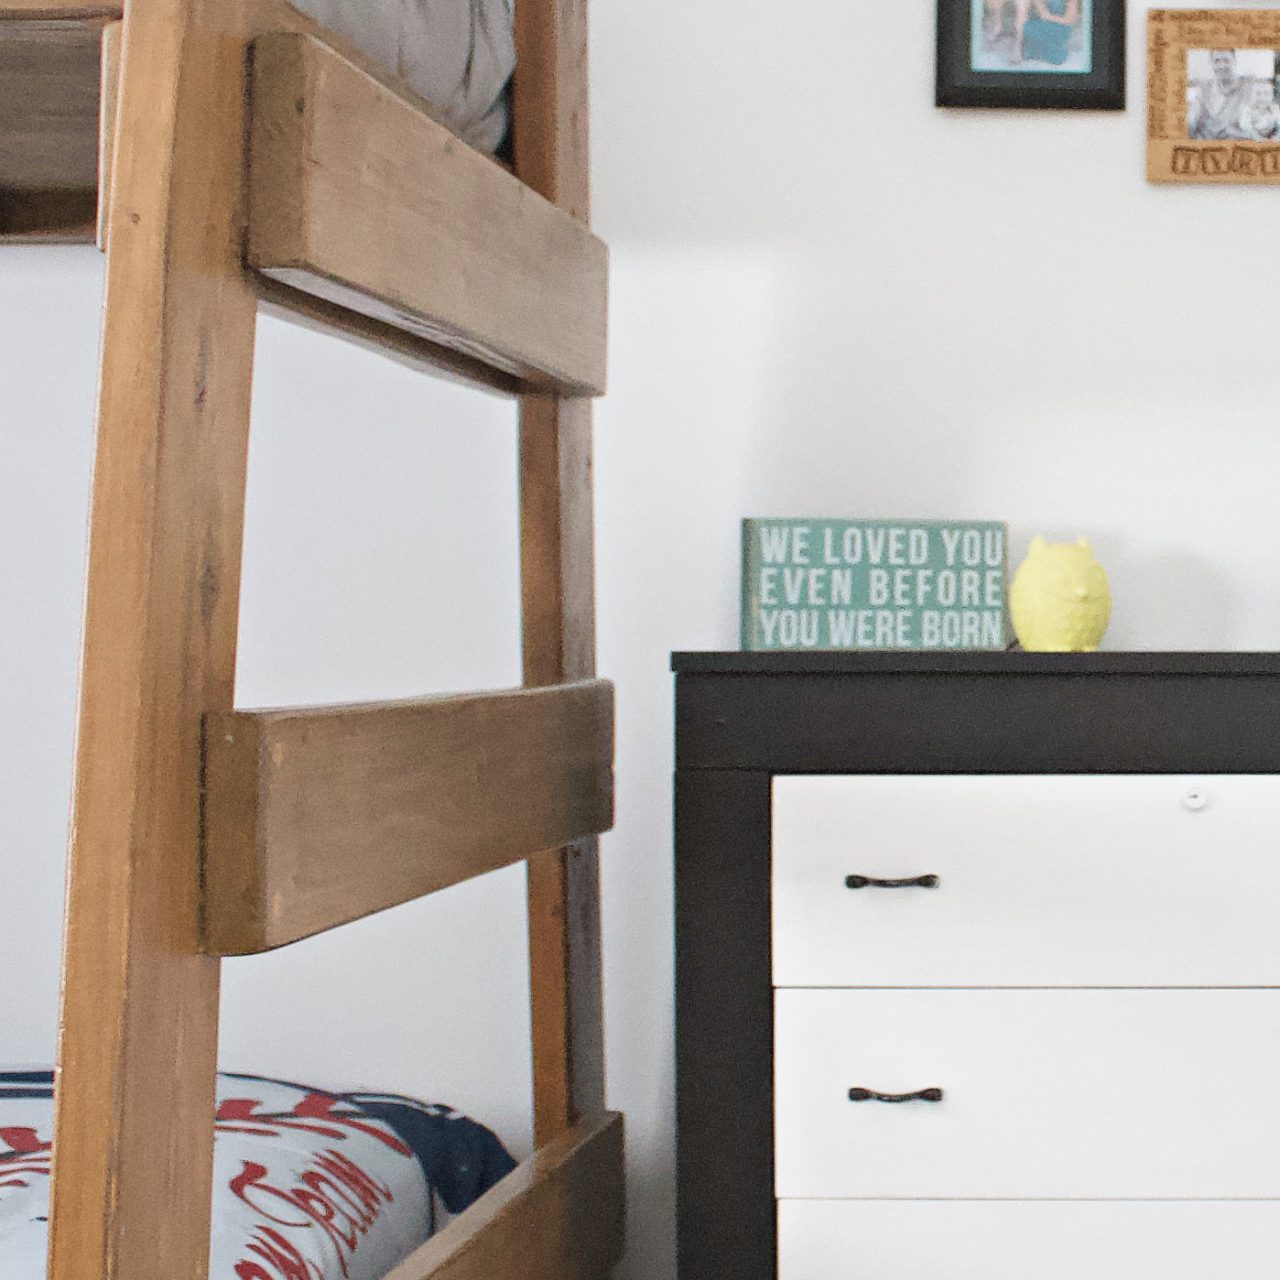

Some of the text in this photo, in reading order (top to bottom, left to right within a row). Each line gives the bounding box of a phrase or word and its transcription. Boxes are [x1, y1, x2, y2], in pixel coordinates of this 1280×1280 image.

[760, 526, 1002, 567] WE LOVED YOU
[760, 567, 1002, 606] EVEN BEFORE
[759, 608, 1002, 648] YOU WERE BORN
